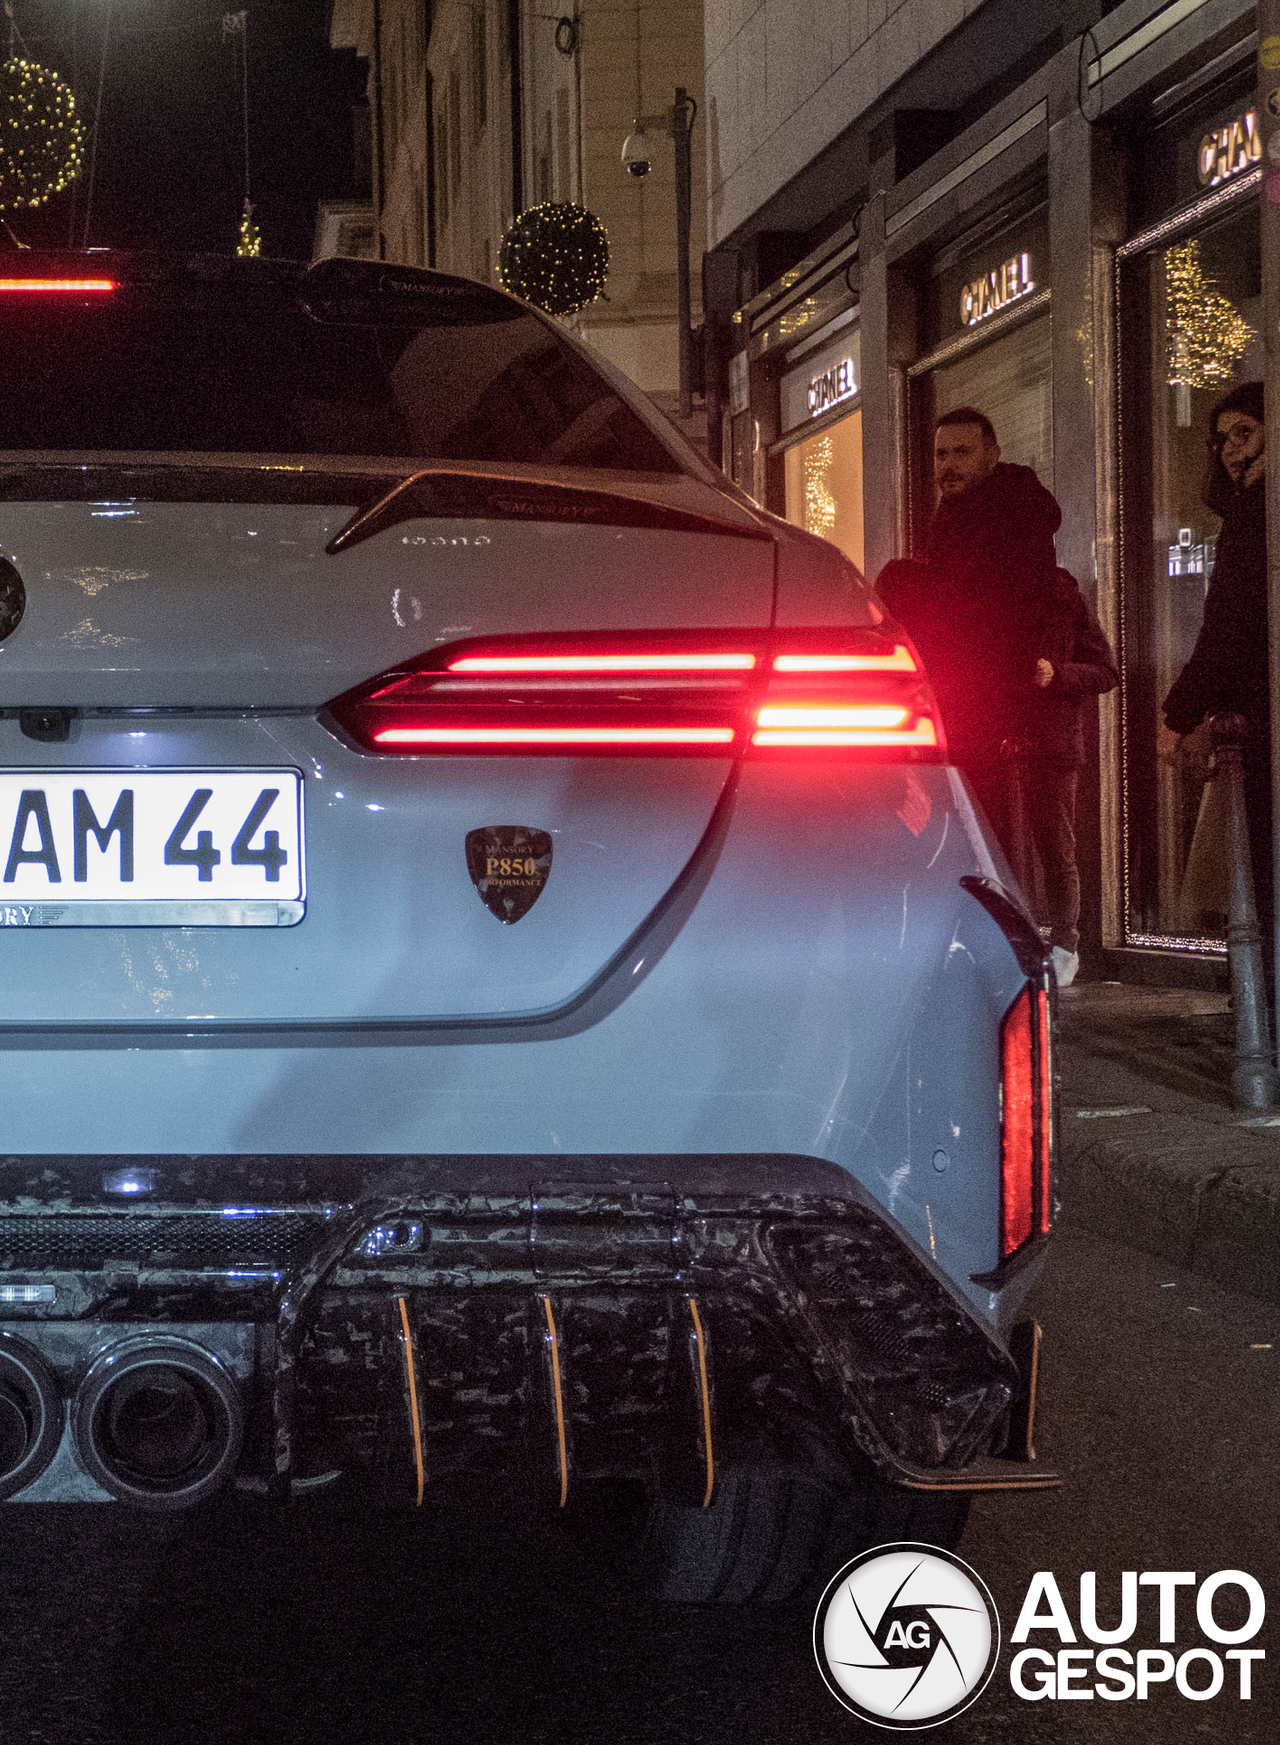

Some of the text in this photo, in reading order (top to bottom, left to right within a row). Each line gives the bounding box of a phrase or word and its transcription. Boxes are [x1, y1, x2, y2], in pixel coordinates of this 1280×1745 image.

[960, 253, 1035, 326] CHANEL
[807, 358, 857, 417] CHANEL
[3, 788, 134, 883] AM
[163, 788, 288, 882] 44
[486, 845, 534, 854] MANSORY
[486, 858, 536, 876] P850
